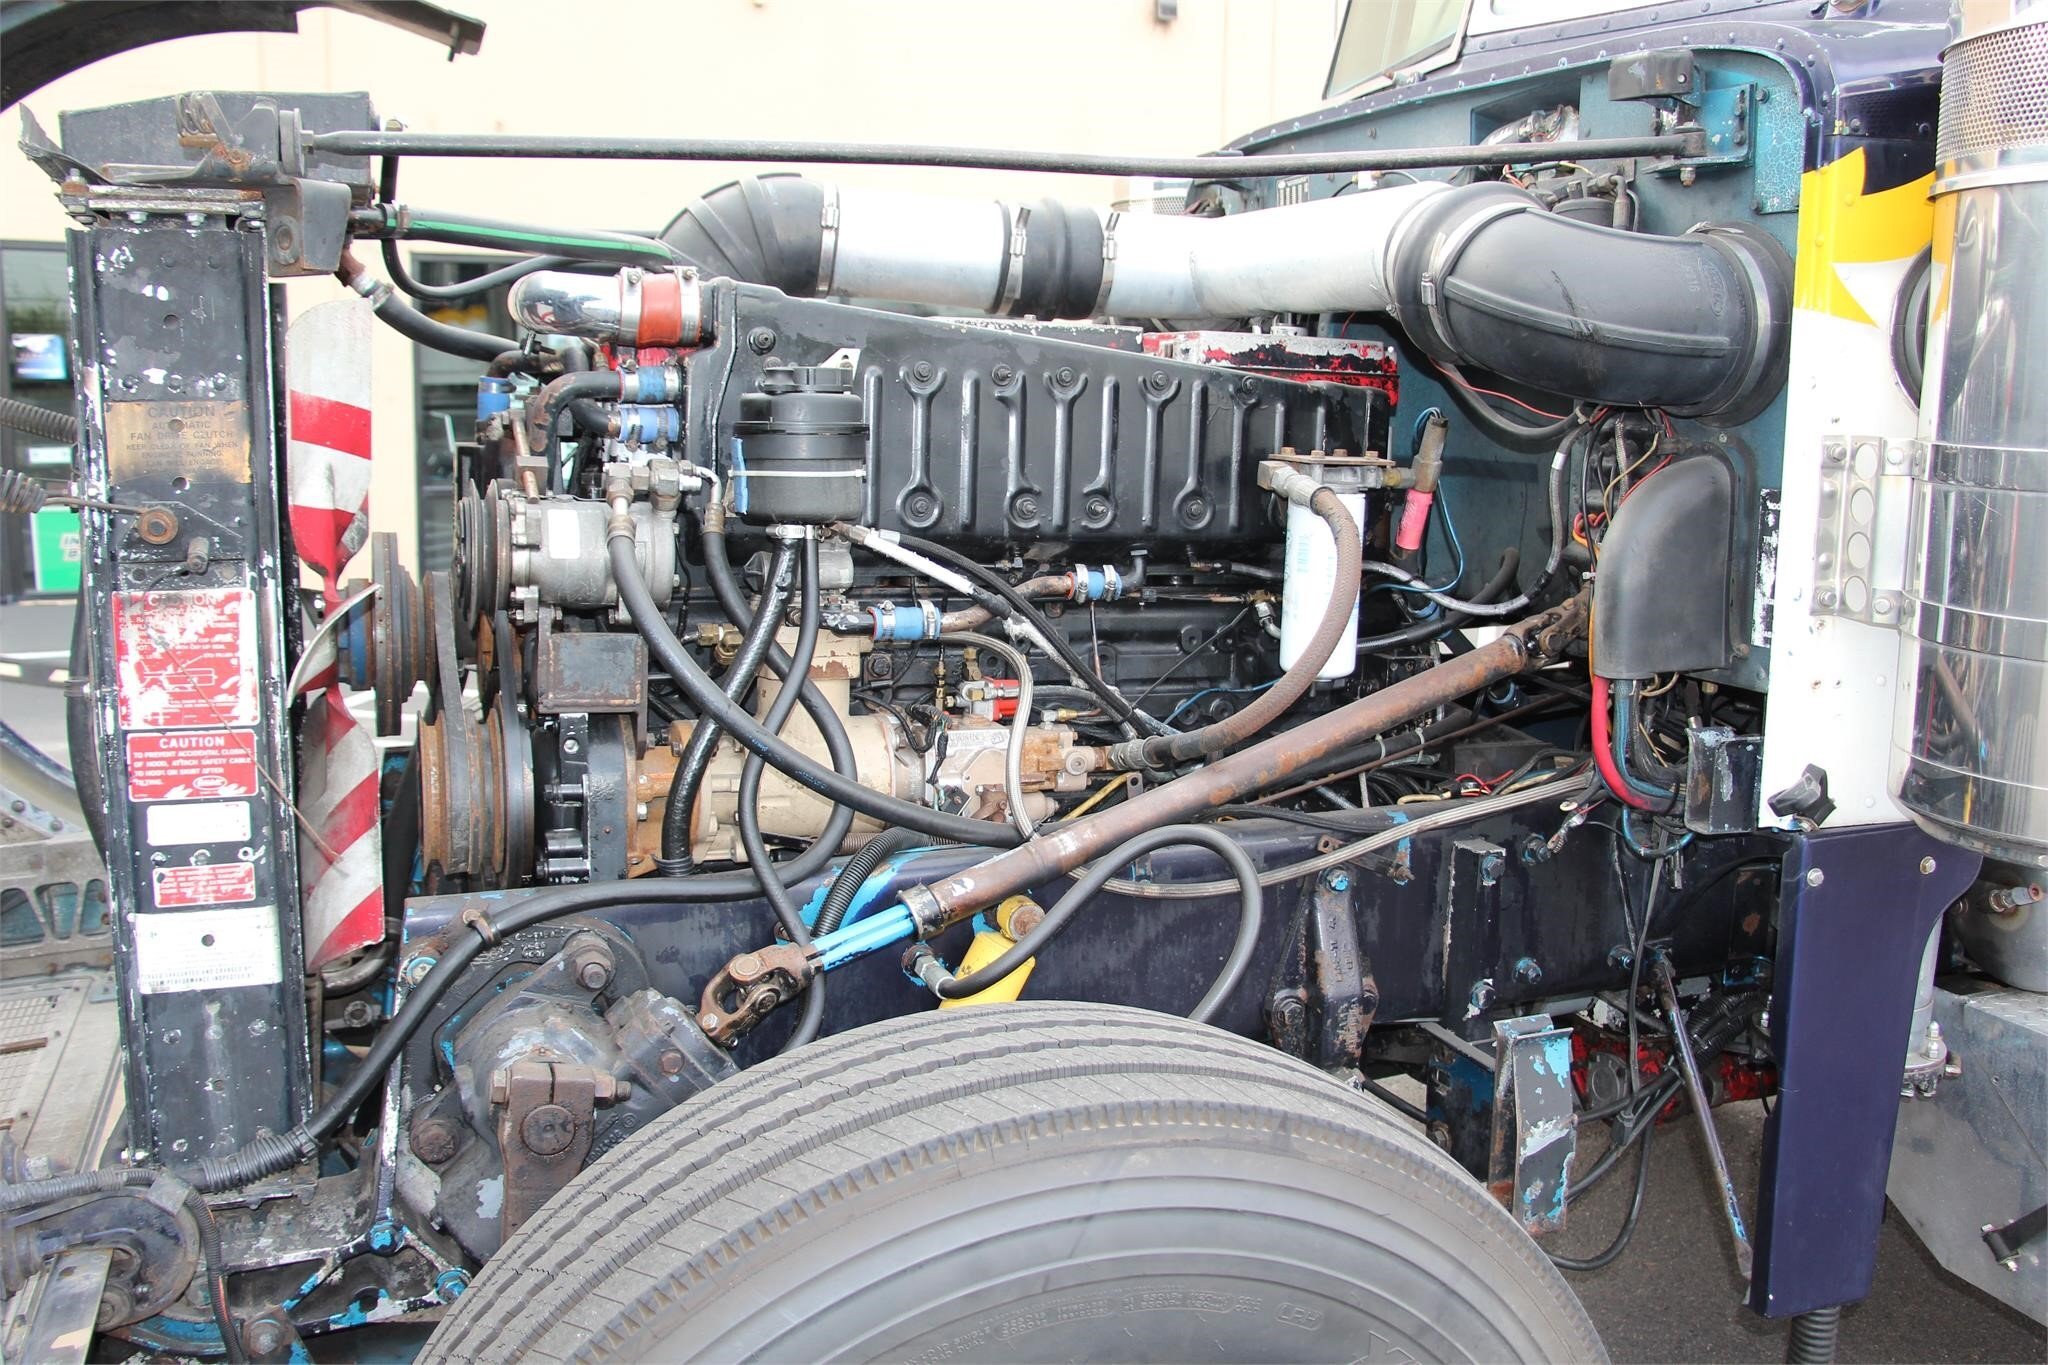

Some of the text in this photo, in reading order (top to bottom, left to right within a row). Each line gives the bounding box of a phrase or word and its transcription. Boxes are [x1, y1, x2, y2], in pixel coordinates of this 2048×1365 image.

[149, 405, 216, 418] CAUTION
[152, 421, 211, 429] AUMATIC
[130, 431, 233, 441] FAN DRIVE CLUTCH
[159, 736, 225, 749] CAUTION
[178, 749, 220, 757] ACCIDENTAL
[201, 757, 227, 765] SAFETY
